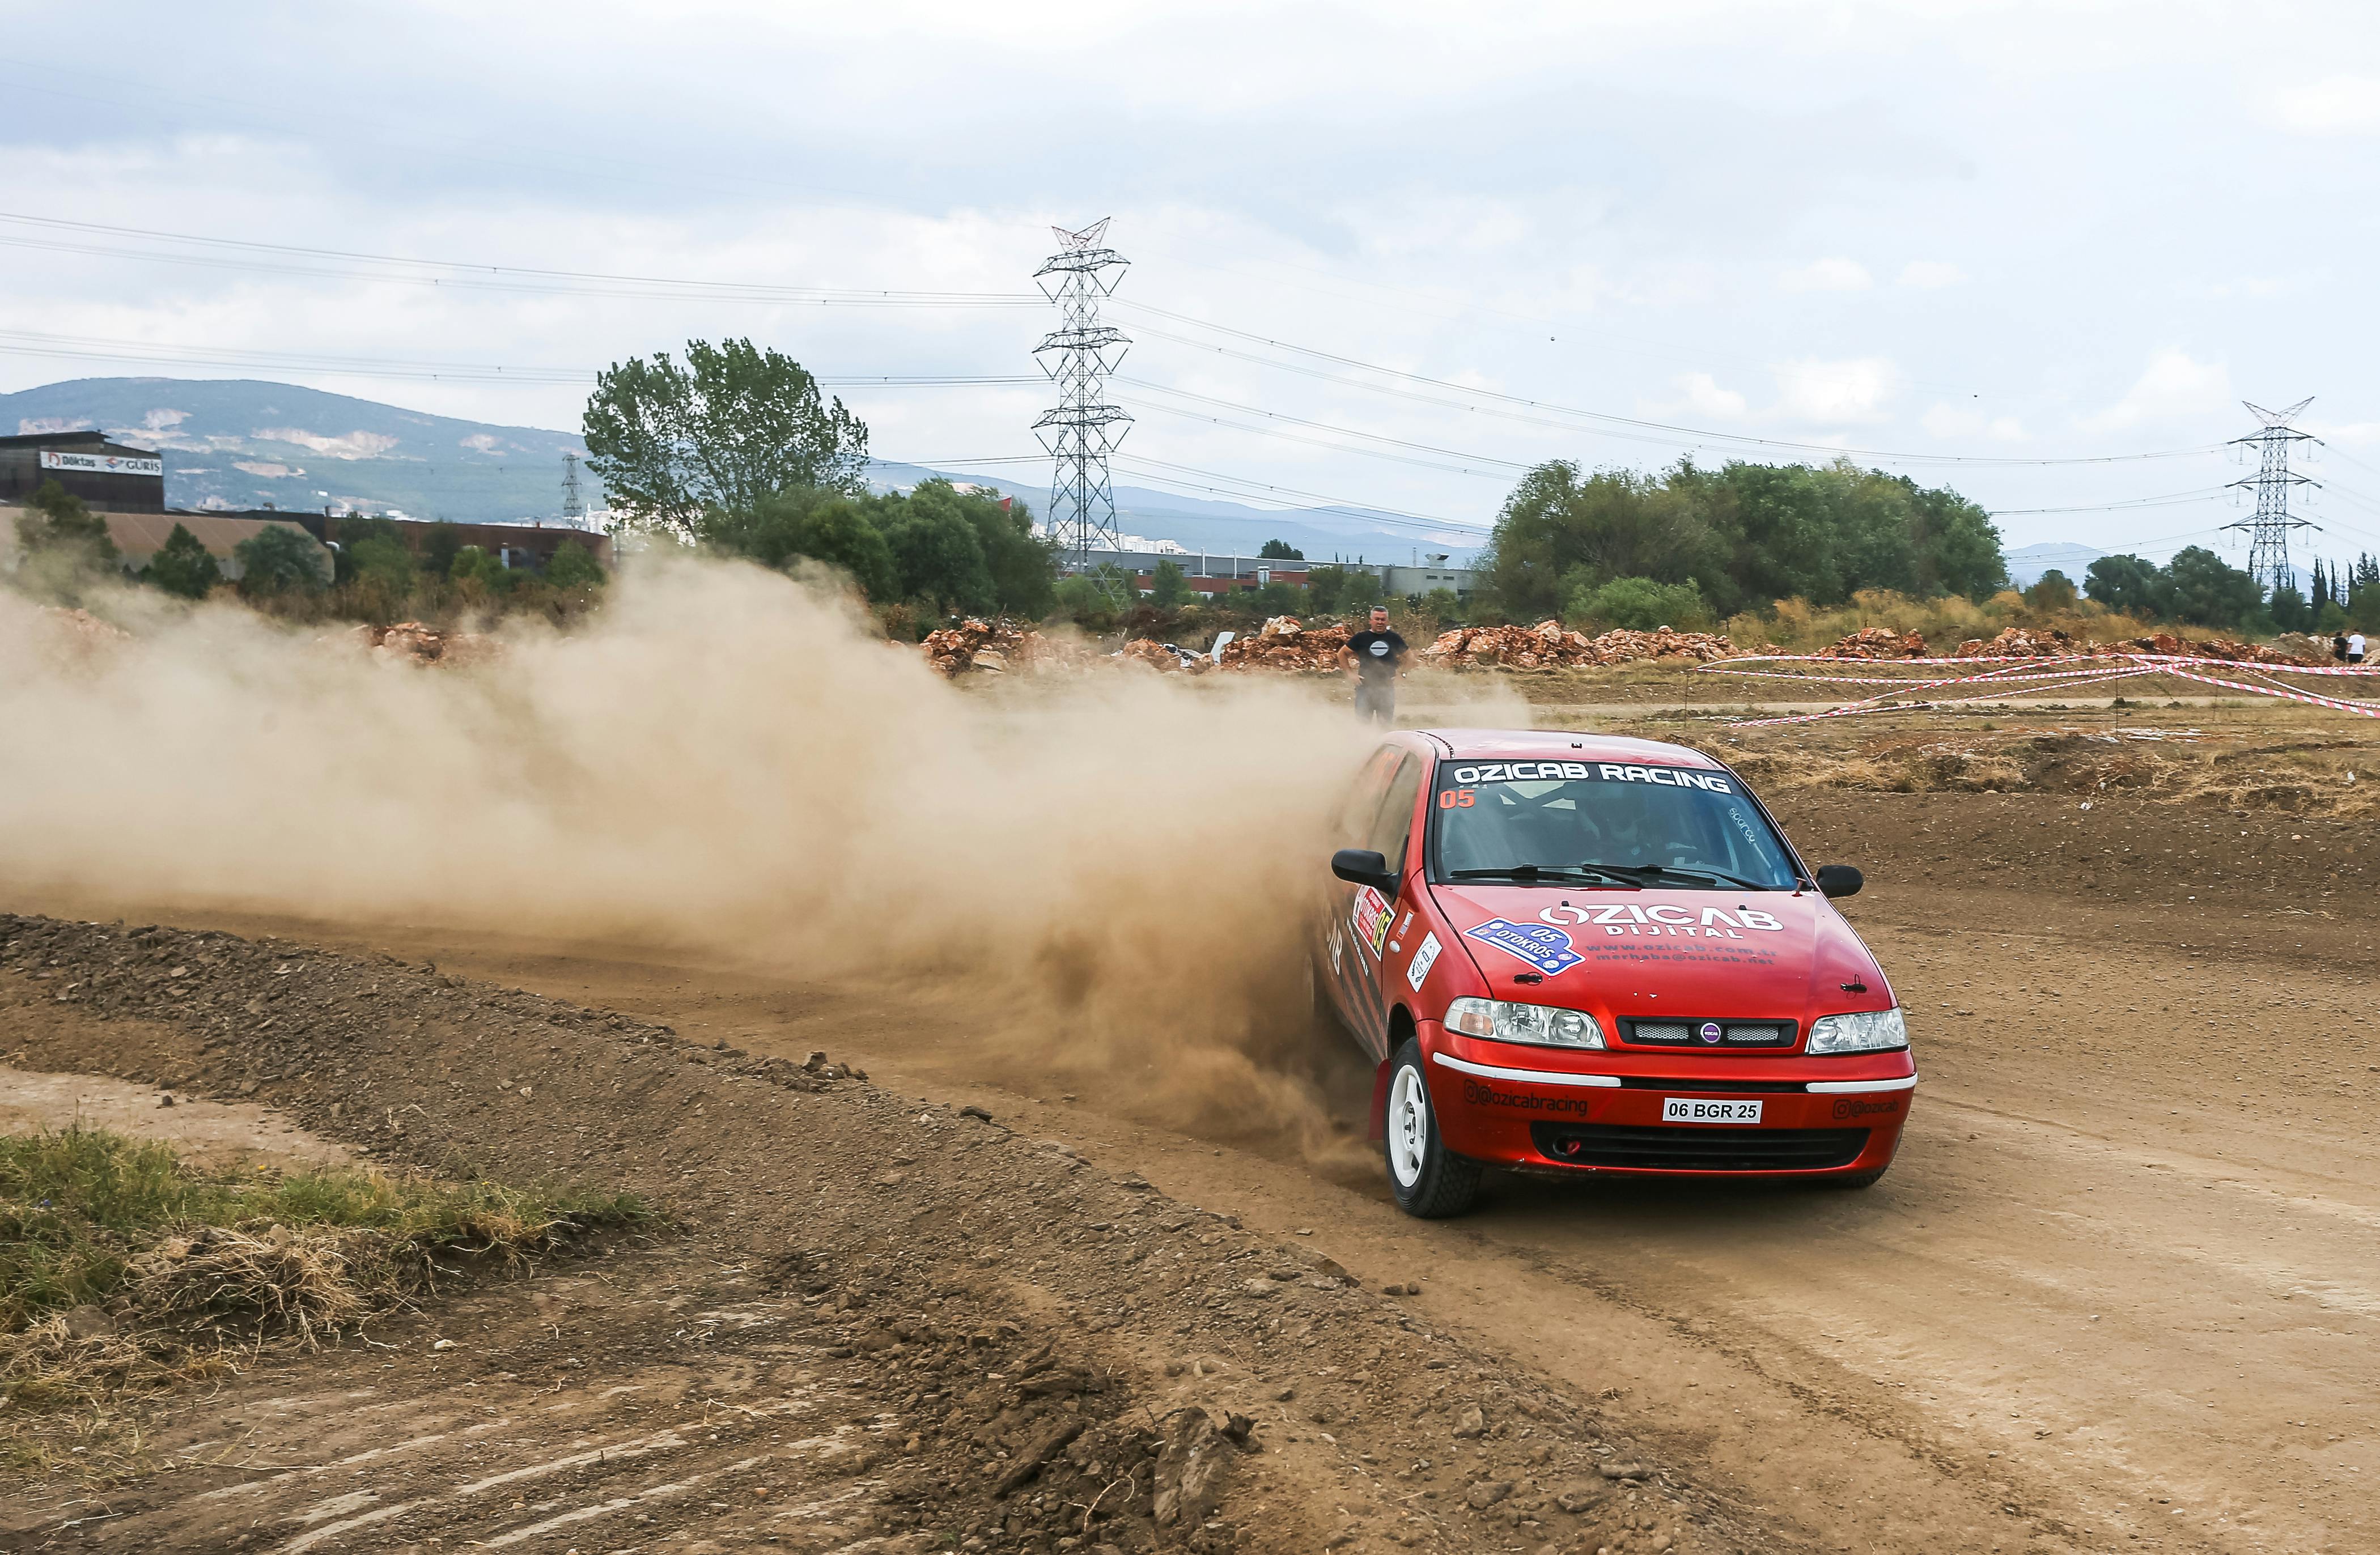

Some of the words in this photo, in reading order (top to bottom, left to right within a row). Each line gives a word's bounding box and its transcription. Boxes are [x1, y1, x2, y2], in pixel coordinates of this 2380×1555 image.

[126, 459, 160, 471] GÜRİŞ
[1454, 762, 1588, 784] OZICAB
[1602, 763, 1732, 794] RACING
[1440, 789, 1475, 809] 05
[1729, 808, 1755, 843] sparco
[1373, 911, 1390, 951] 05
[1538, 904, 1784, 931] OZICAB
[1495, 929, 1555, 958] OTOKROS
[1530, 928, 1563, 943] 05
[1586, 943, 1778, 957] www.ozicab.com.tr
[1478, 1085, 1588, 1117] @ozicabracing
[1669, 1103, 1689, 1117] 06
[1694, 1104, 1733, 1118] BGR
[1737, 1104, 1757, 1118] 25
